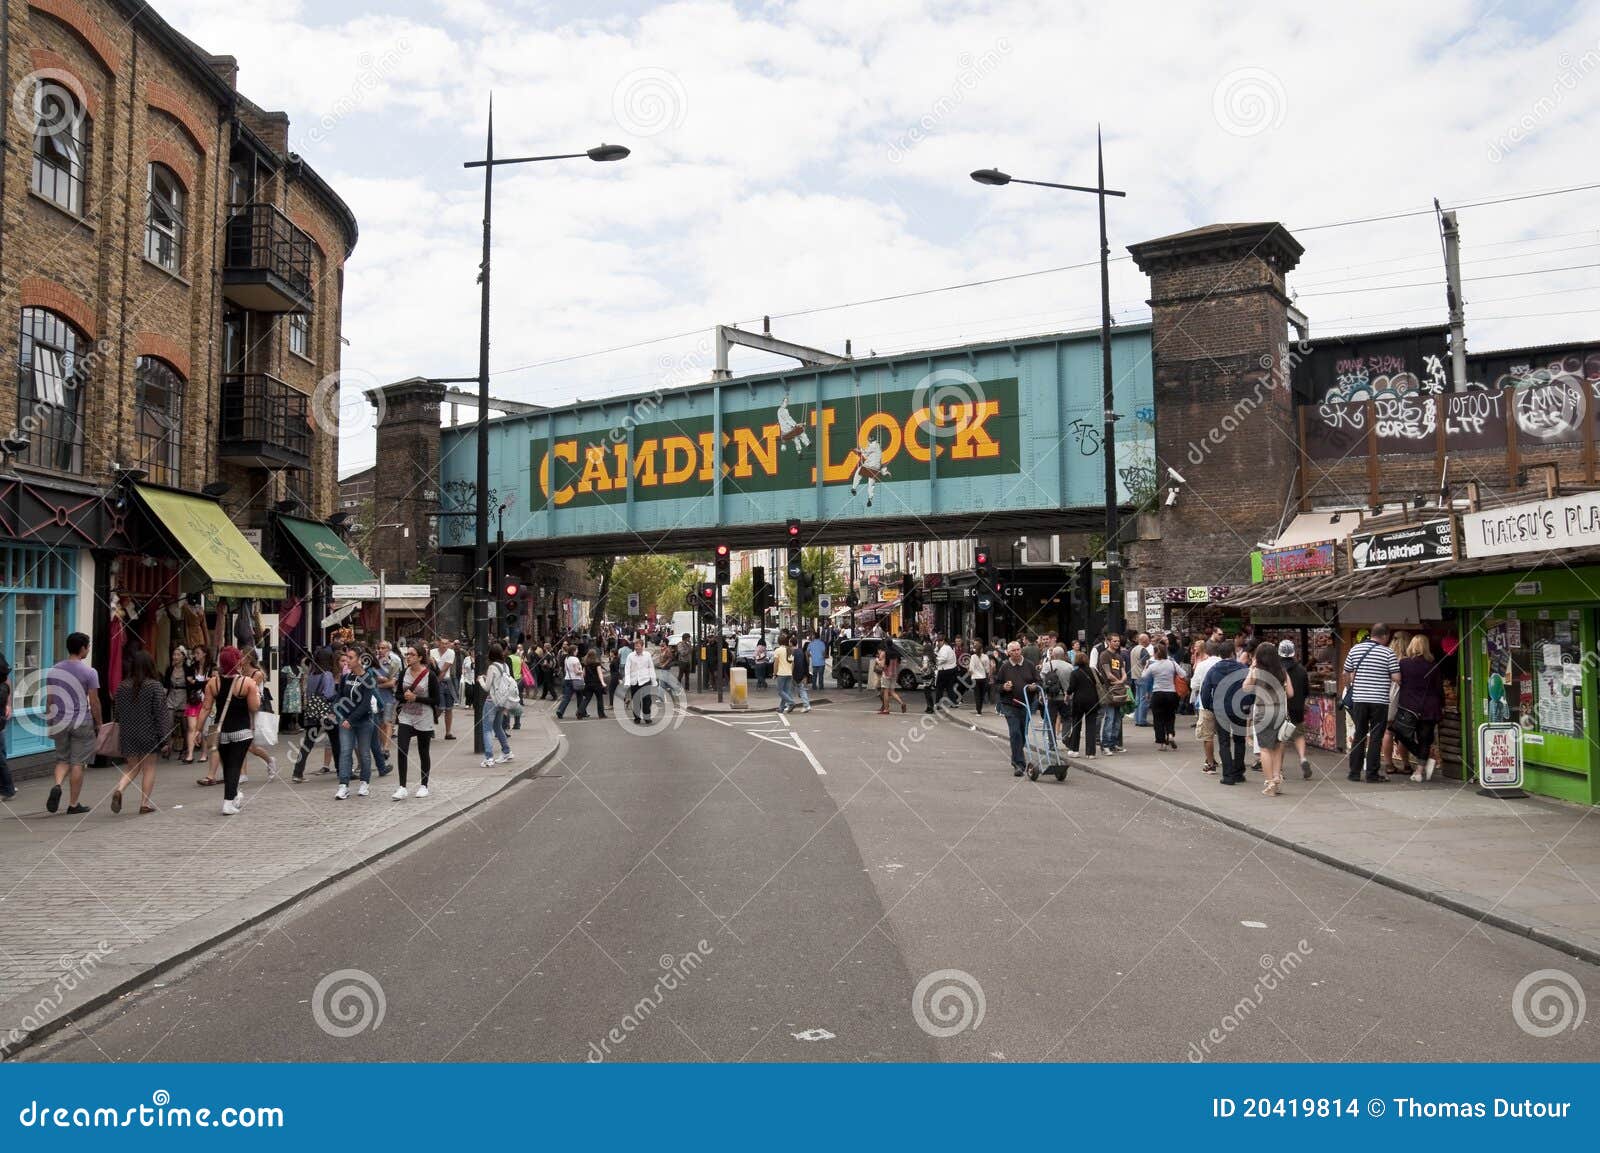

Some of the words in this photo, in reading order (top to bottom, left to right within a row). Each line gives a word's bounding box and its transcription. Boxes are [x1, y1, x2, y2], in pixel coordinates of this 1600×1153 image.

[538, 422, 781, 505] CAMDEN
[811, 400, 1001, 484] LOCK
[1388, 543, 1424, 560] kitchen
